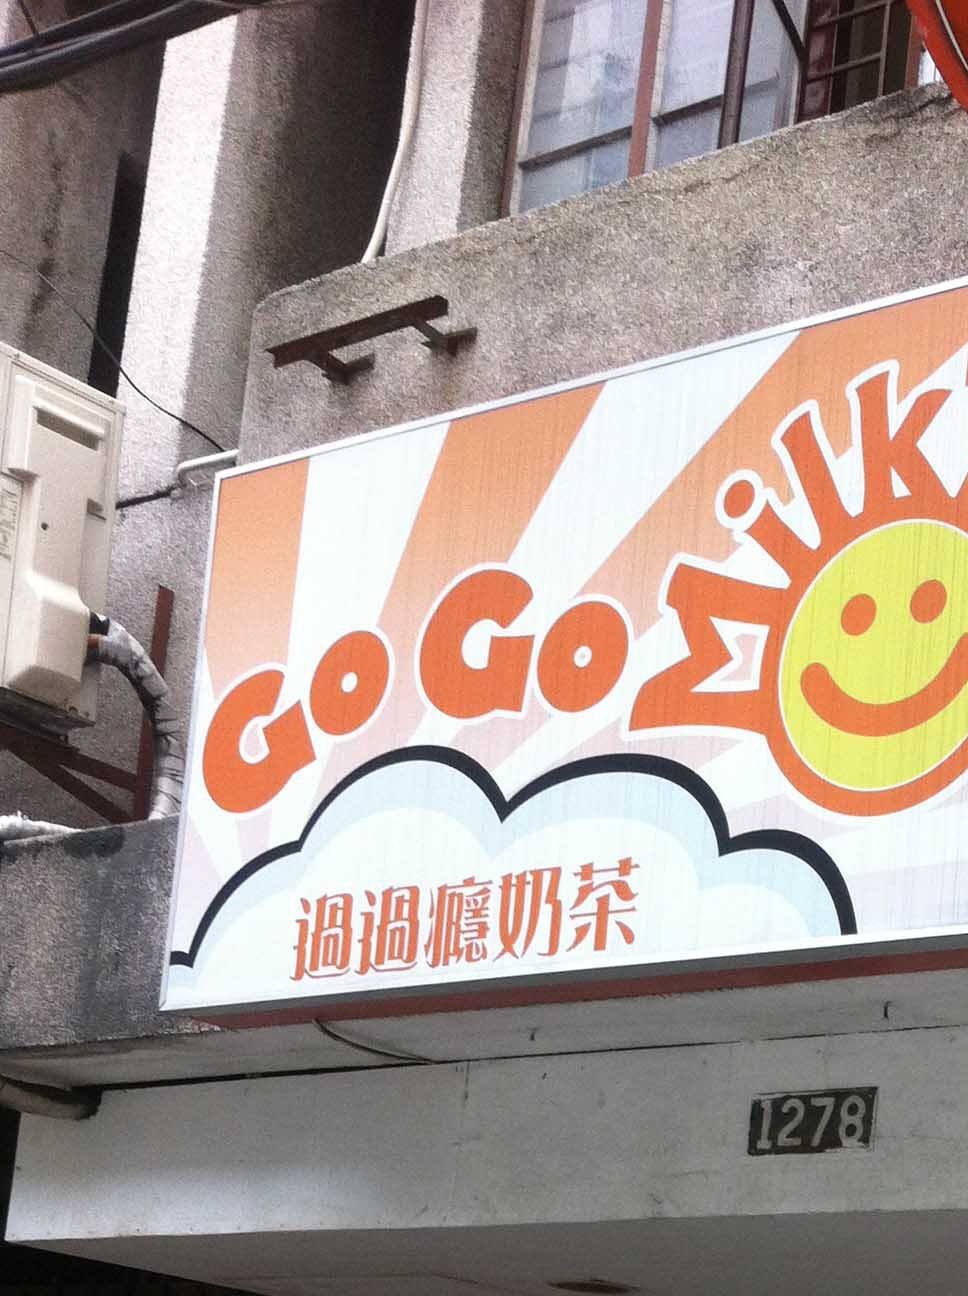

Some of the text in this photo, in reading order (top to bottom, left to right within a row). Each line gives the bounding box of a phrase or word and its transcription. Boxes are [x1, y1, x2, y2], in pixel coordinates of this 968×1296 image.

[289, 857, 641, 982] 過過癮奶茶
[756, 1095, 866, 1149] 1278
